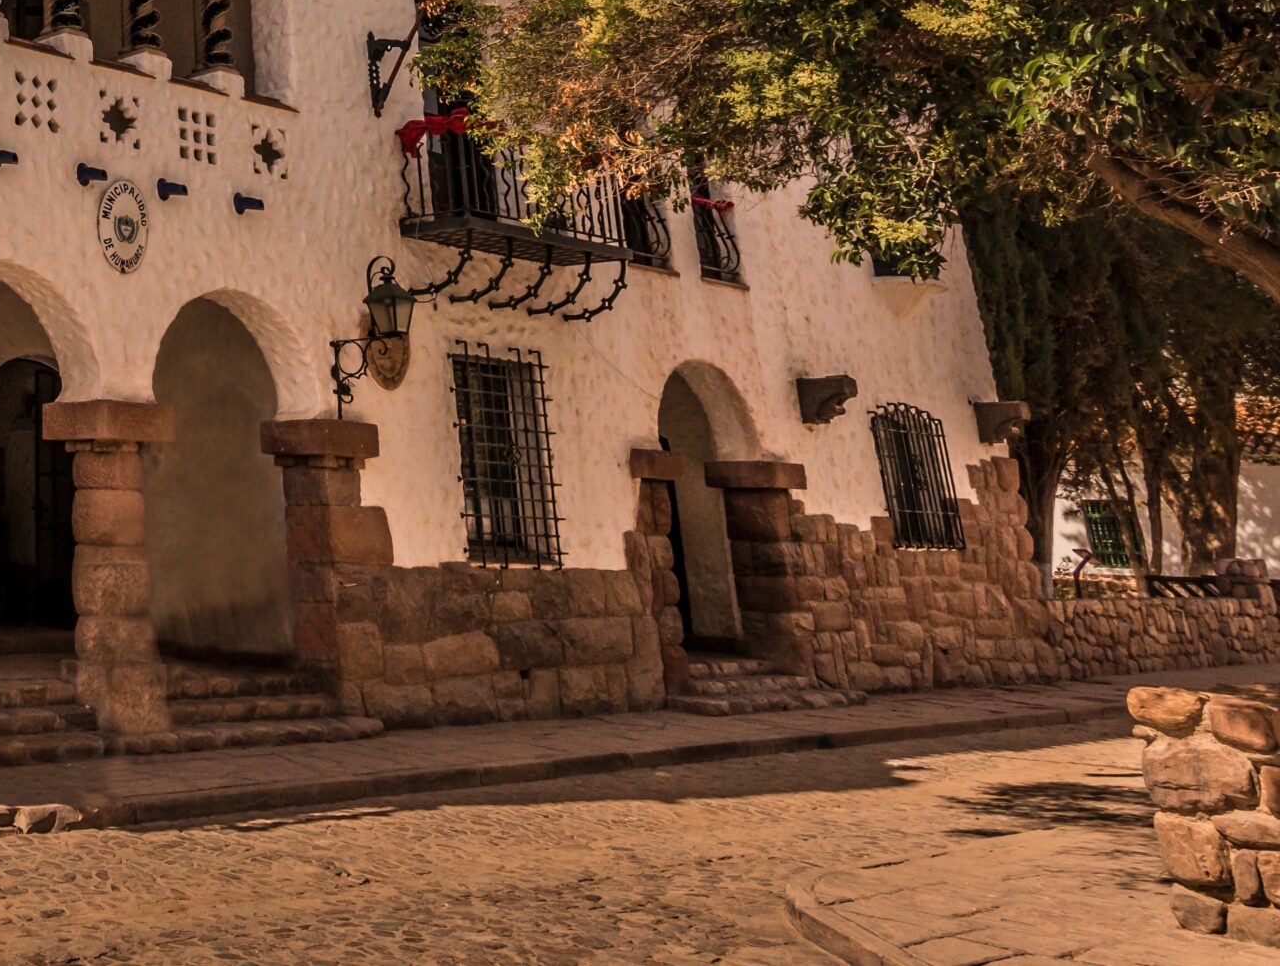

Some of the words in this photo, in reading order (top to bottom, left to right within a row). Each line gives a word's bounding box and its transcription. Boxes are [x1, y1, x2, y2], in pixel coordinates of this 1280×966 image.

[102, 183, 147, 227] MUNICIPALIDAD
[103, 237, 115, 251] DE
[109, 244, 145, 270] HUMAHUACA
